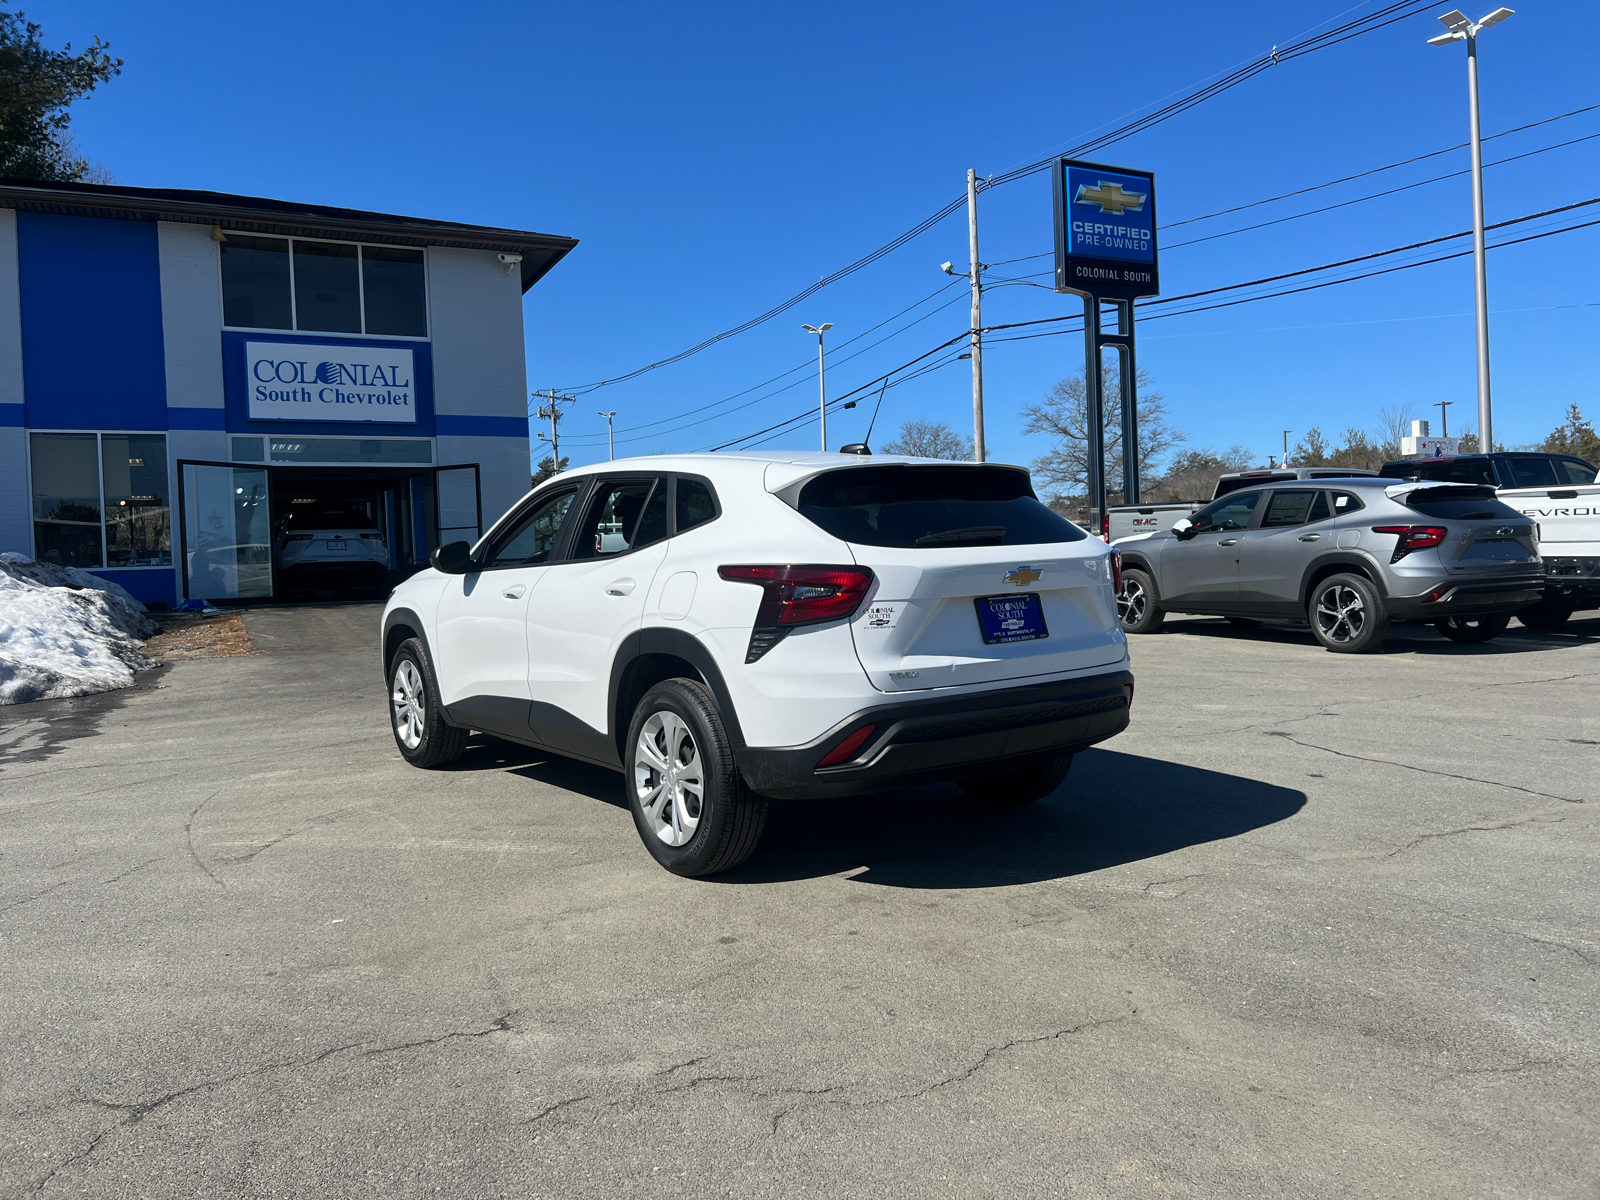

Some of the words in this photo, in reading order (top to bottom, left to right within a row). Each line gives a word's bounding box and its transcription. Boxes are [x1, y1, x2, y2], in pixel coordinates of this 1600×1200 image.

[1072, 221, 1151, 240] CERTIFIED
[1077, 234, 1148, 251] PRE-OWNED
[1076, 266, 1119, 280] COLONIAL
[1124, 270, 1151, 283] SOUTH
[253, 359, 409, 388] COLONIAL
[255, 385, 312, 402] South
[318, 387, 409, 405] Chevrolet
[1518, 507, 1600, 517] EVROL
[1132, 518, 1158, 526] GMC
[990, 601, 1028, 612] COLONIAL
[998, 610, 1024, 619] SOUTH
